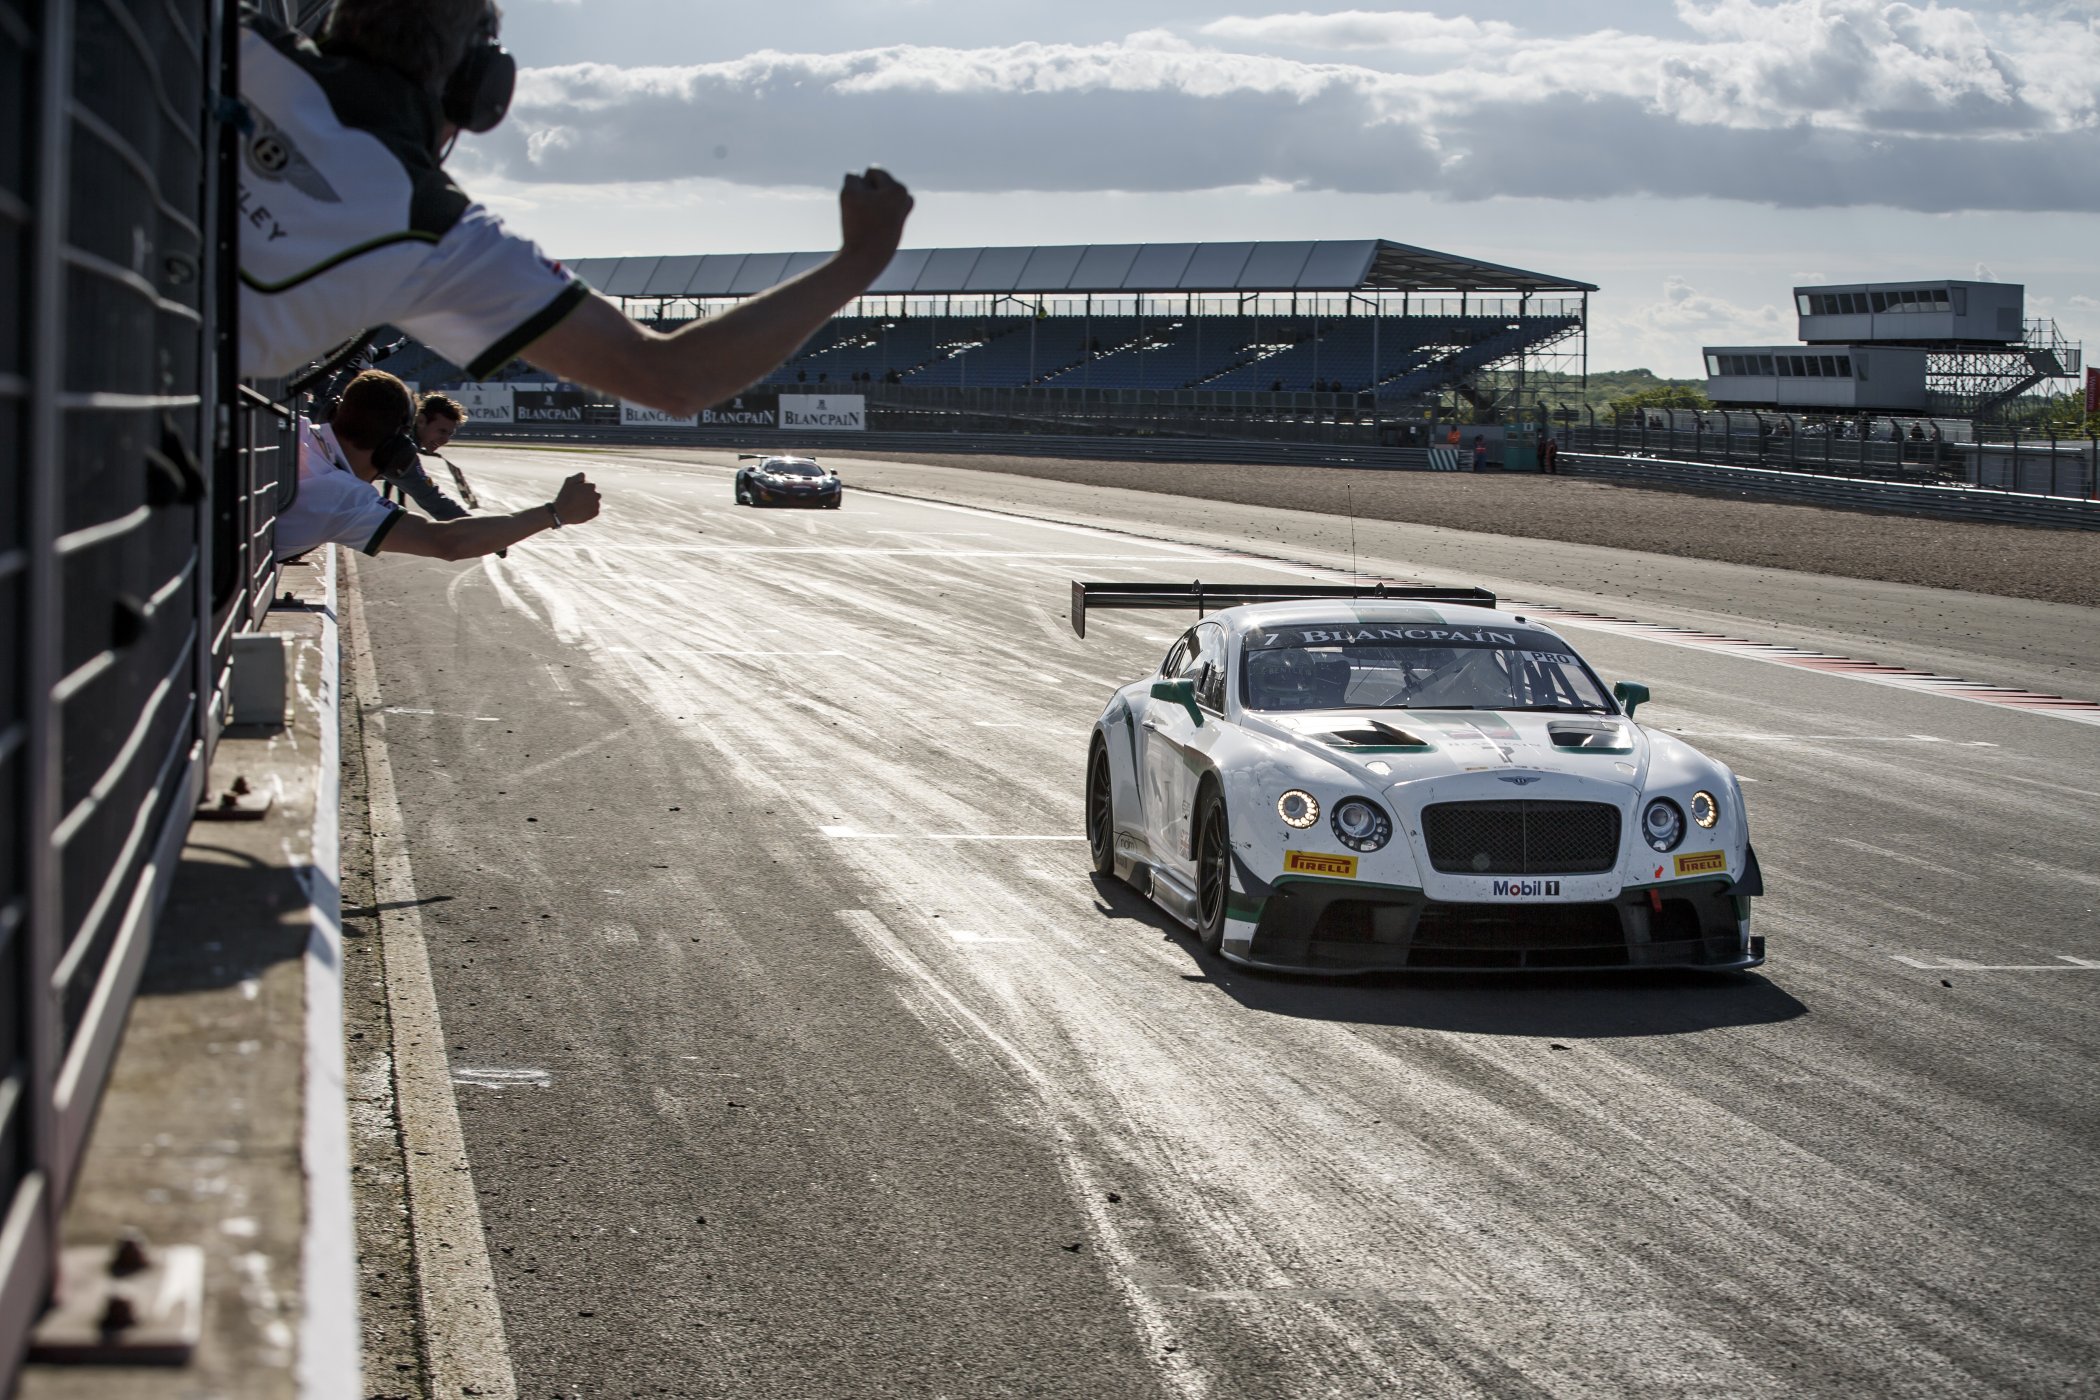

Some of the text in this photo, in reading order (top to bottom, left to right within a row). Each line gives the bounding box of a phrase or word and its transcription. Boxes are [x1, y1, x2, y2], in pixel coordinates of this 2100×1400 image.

[518, 405, 582, 420] BLANCPAIN
[702, 409, 776, 425] BLANCPAIN
[784, 410, 860, 426] BLANCPAIN
[1264, 629, 1517, 646] 7 BLANCPAIN
[1532, 652, 1570, 665] PRO
[1482, 745, 1516, 764] 7
[1493, 880, 1541, 896] Mobil
